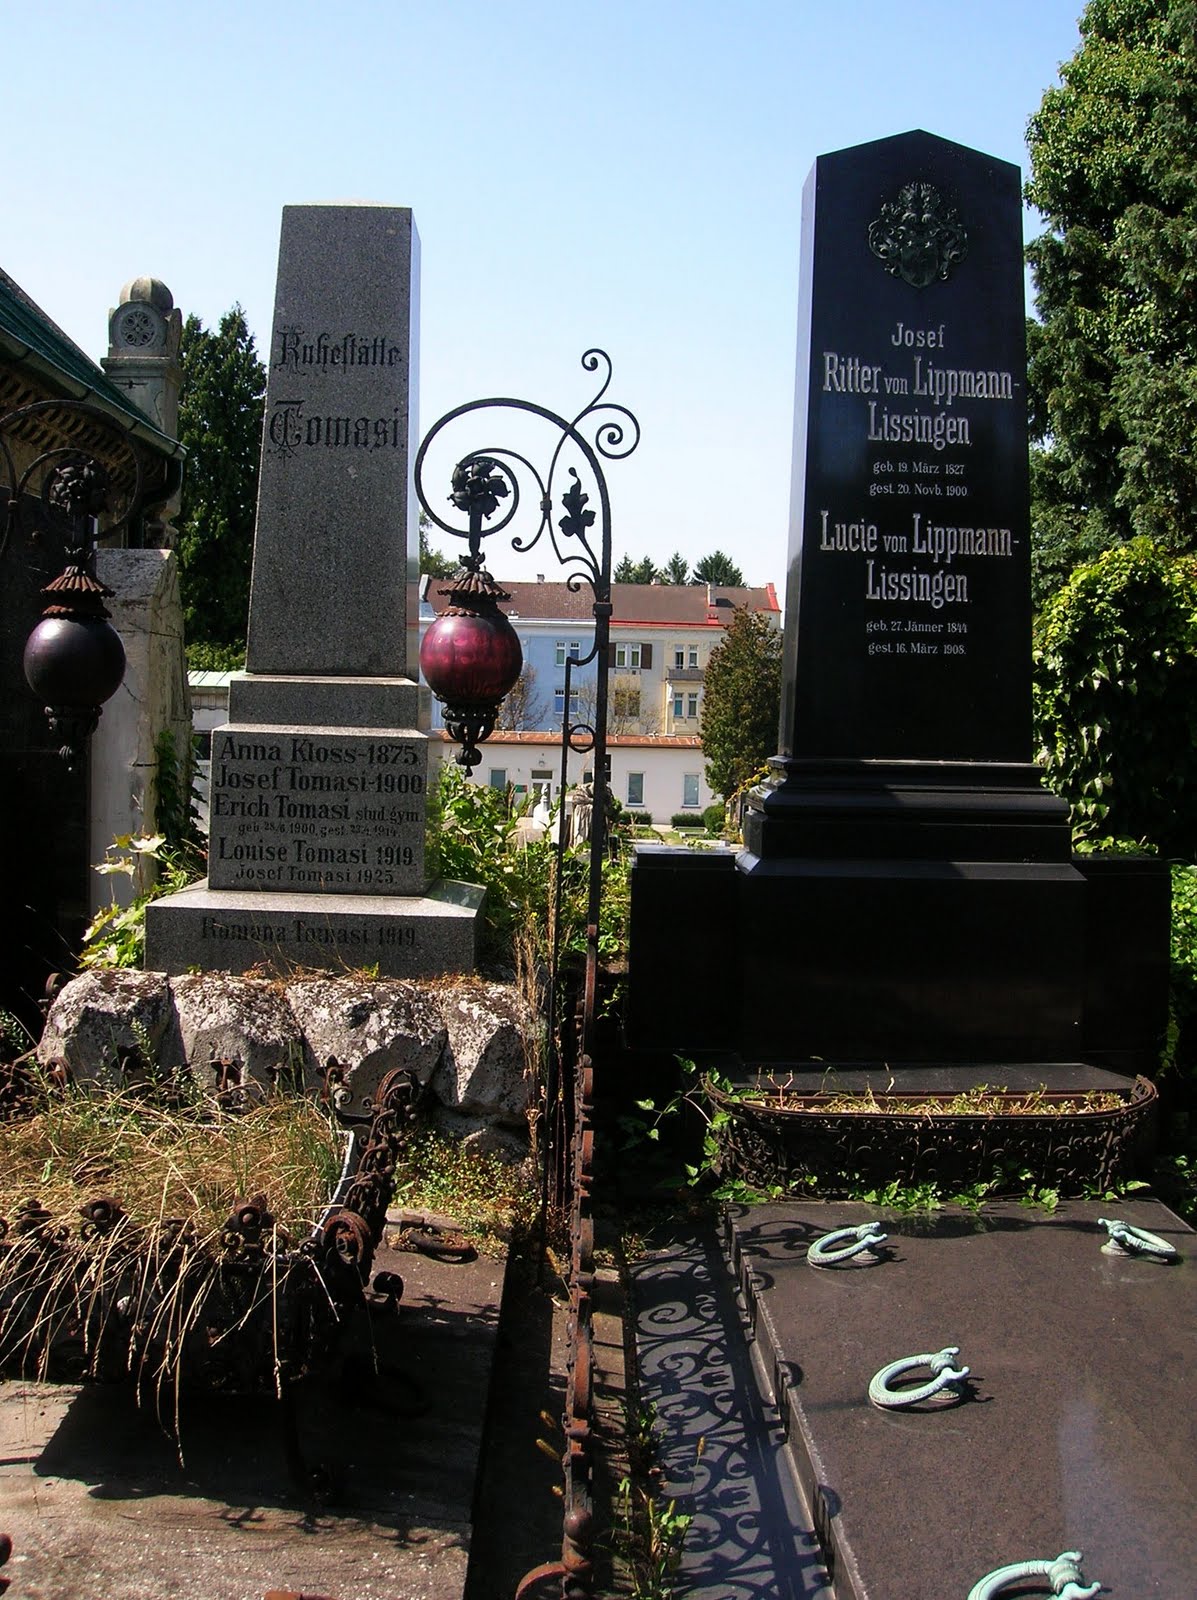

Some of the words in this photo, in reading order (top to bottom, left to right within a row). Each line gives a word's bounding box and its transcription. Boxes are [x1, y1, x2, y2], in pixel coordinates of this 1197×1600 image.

[891, 322, 945, 349] Josef
[823, 351, 882, 394] Ritter
[883, 376, 909, 396] von
[913, 355, 1021, 406] Lippmann-
[873, 461, 895, 475] geb.
[898, 462, 909, 474] 19.
[912, 461, 940, 475] März
[945, 464, 965, 475] 1827
[897, 483, 912, 495] 20.
[914, 483, 943, 496] Novb.
[820, 510, 878, 552] Lucie
[883, 535, 908, 553] von
[912, 513, 1020, 564] Lippmann-
[866, 620, 889, 633] geb.
[904, 621, 944, 634] Jänner
[947, 622, 968, 634] 1844
[896, 642, 909, 654] 16.
[910, 642, 939, 655] März
[220, 736, 282, 762] Anna
[215, 764, 282, 790] Josef
[215, 793, 270, 818] Erich
[273, 794, 351, 821] Tomasi
[219, 836, 288, 862] Louise
[293, 839, 369, 865] Tomasi
[235, 864, 283, 881] Josef
[286, 865, 352, 883] Tomasi
[200, 916, 287, 943] Romana
[293, 919, 370, 945] Tomasi
